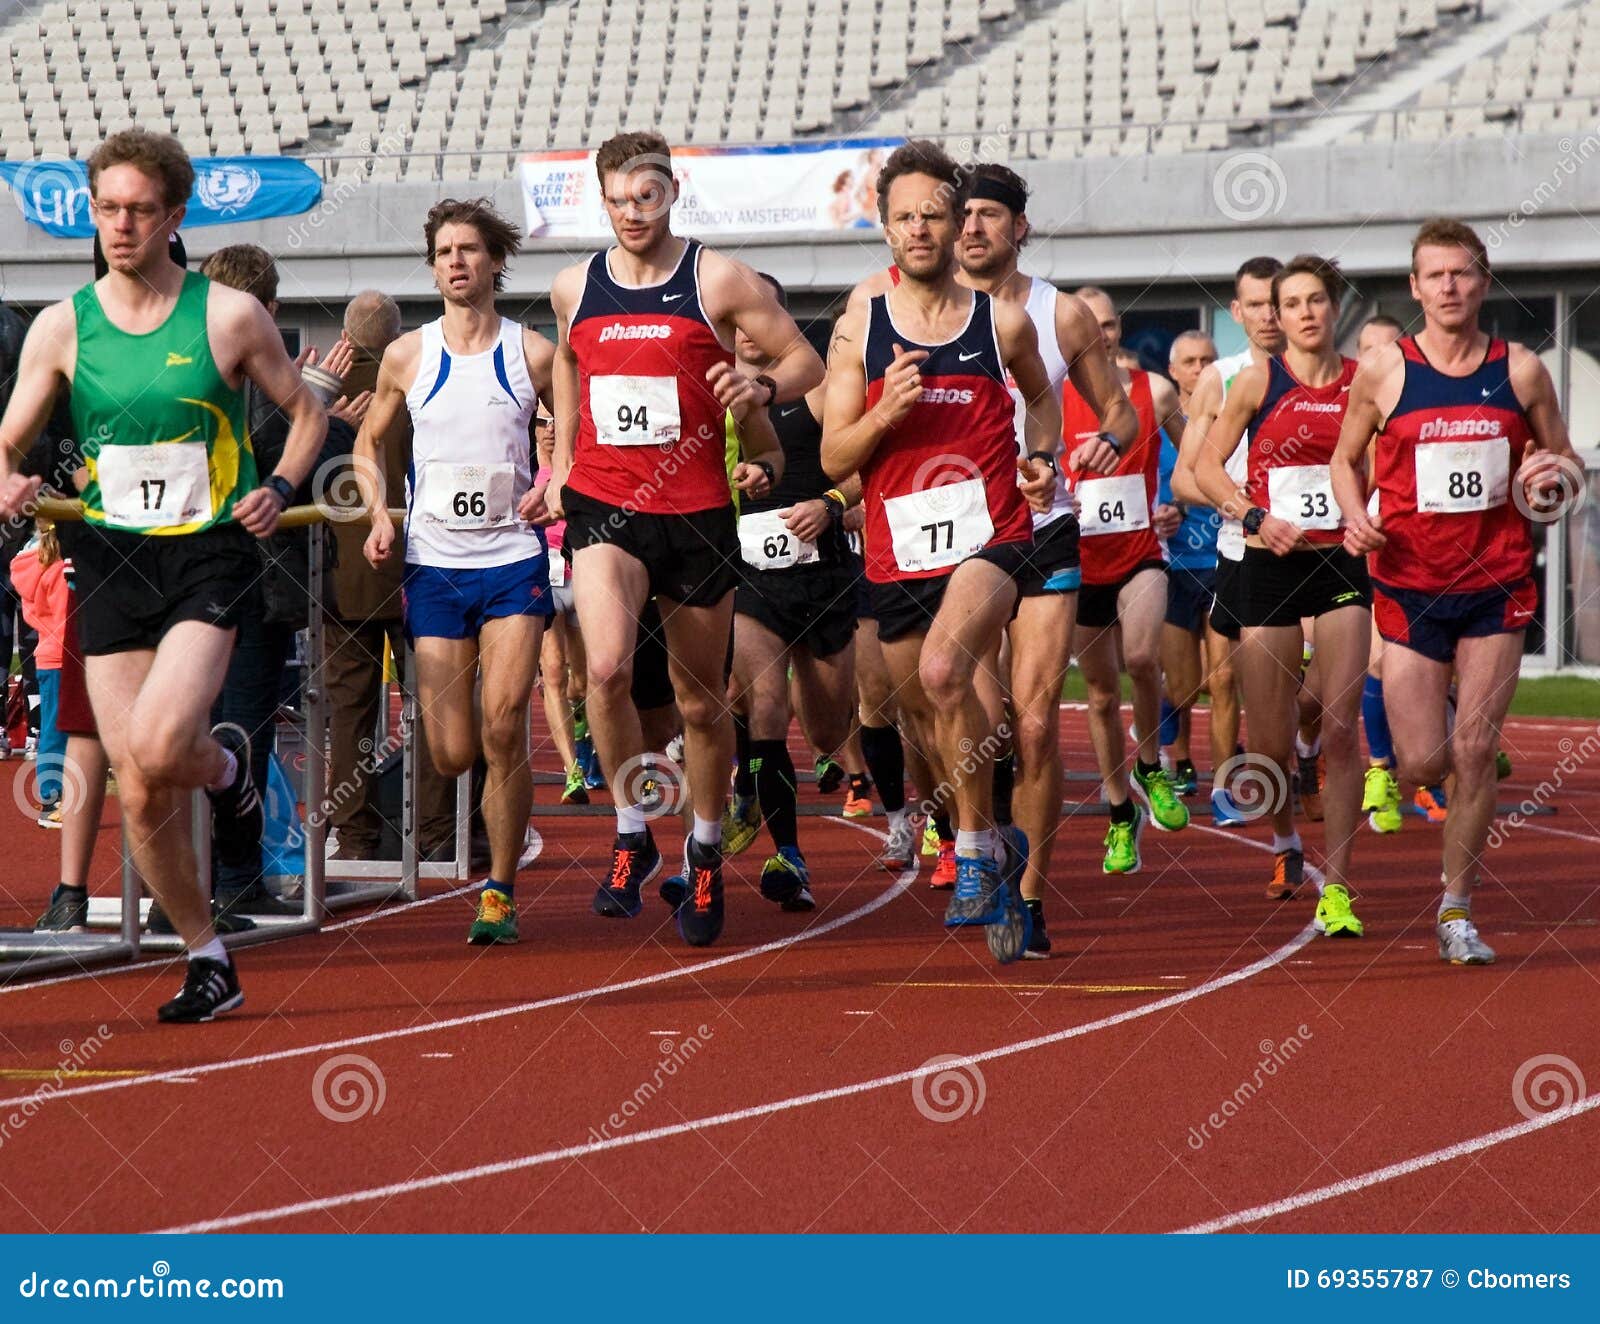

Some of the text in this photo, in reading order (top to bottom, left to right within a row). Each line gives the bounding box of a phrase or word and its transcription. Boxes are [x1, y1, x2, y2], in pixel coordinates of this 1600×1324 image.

[677, 205, 817, 226] STADION AMSTERDAM
[599, 322, 674, 343] phanos
[916, 387, 977, 405] anos
[1294, 401, 1341, 412] phanos
[617, 405, 649, 432] 94
[1419, 416, 1500, 440] phanos
[140, 480, 166, 510] 17
[1448, 471, 1483, 499] 88
[453, 491, 486, 517] 66
[1098, 500, 1125, 523] 64
[1300, 493, 1329, 518] 33
[763, 534, 791, 558] 62
[921, 519, 954, 553] 77
